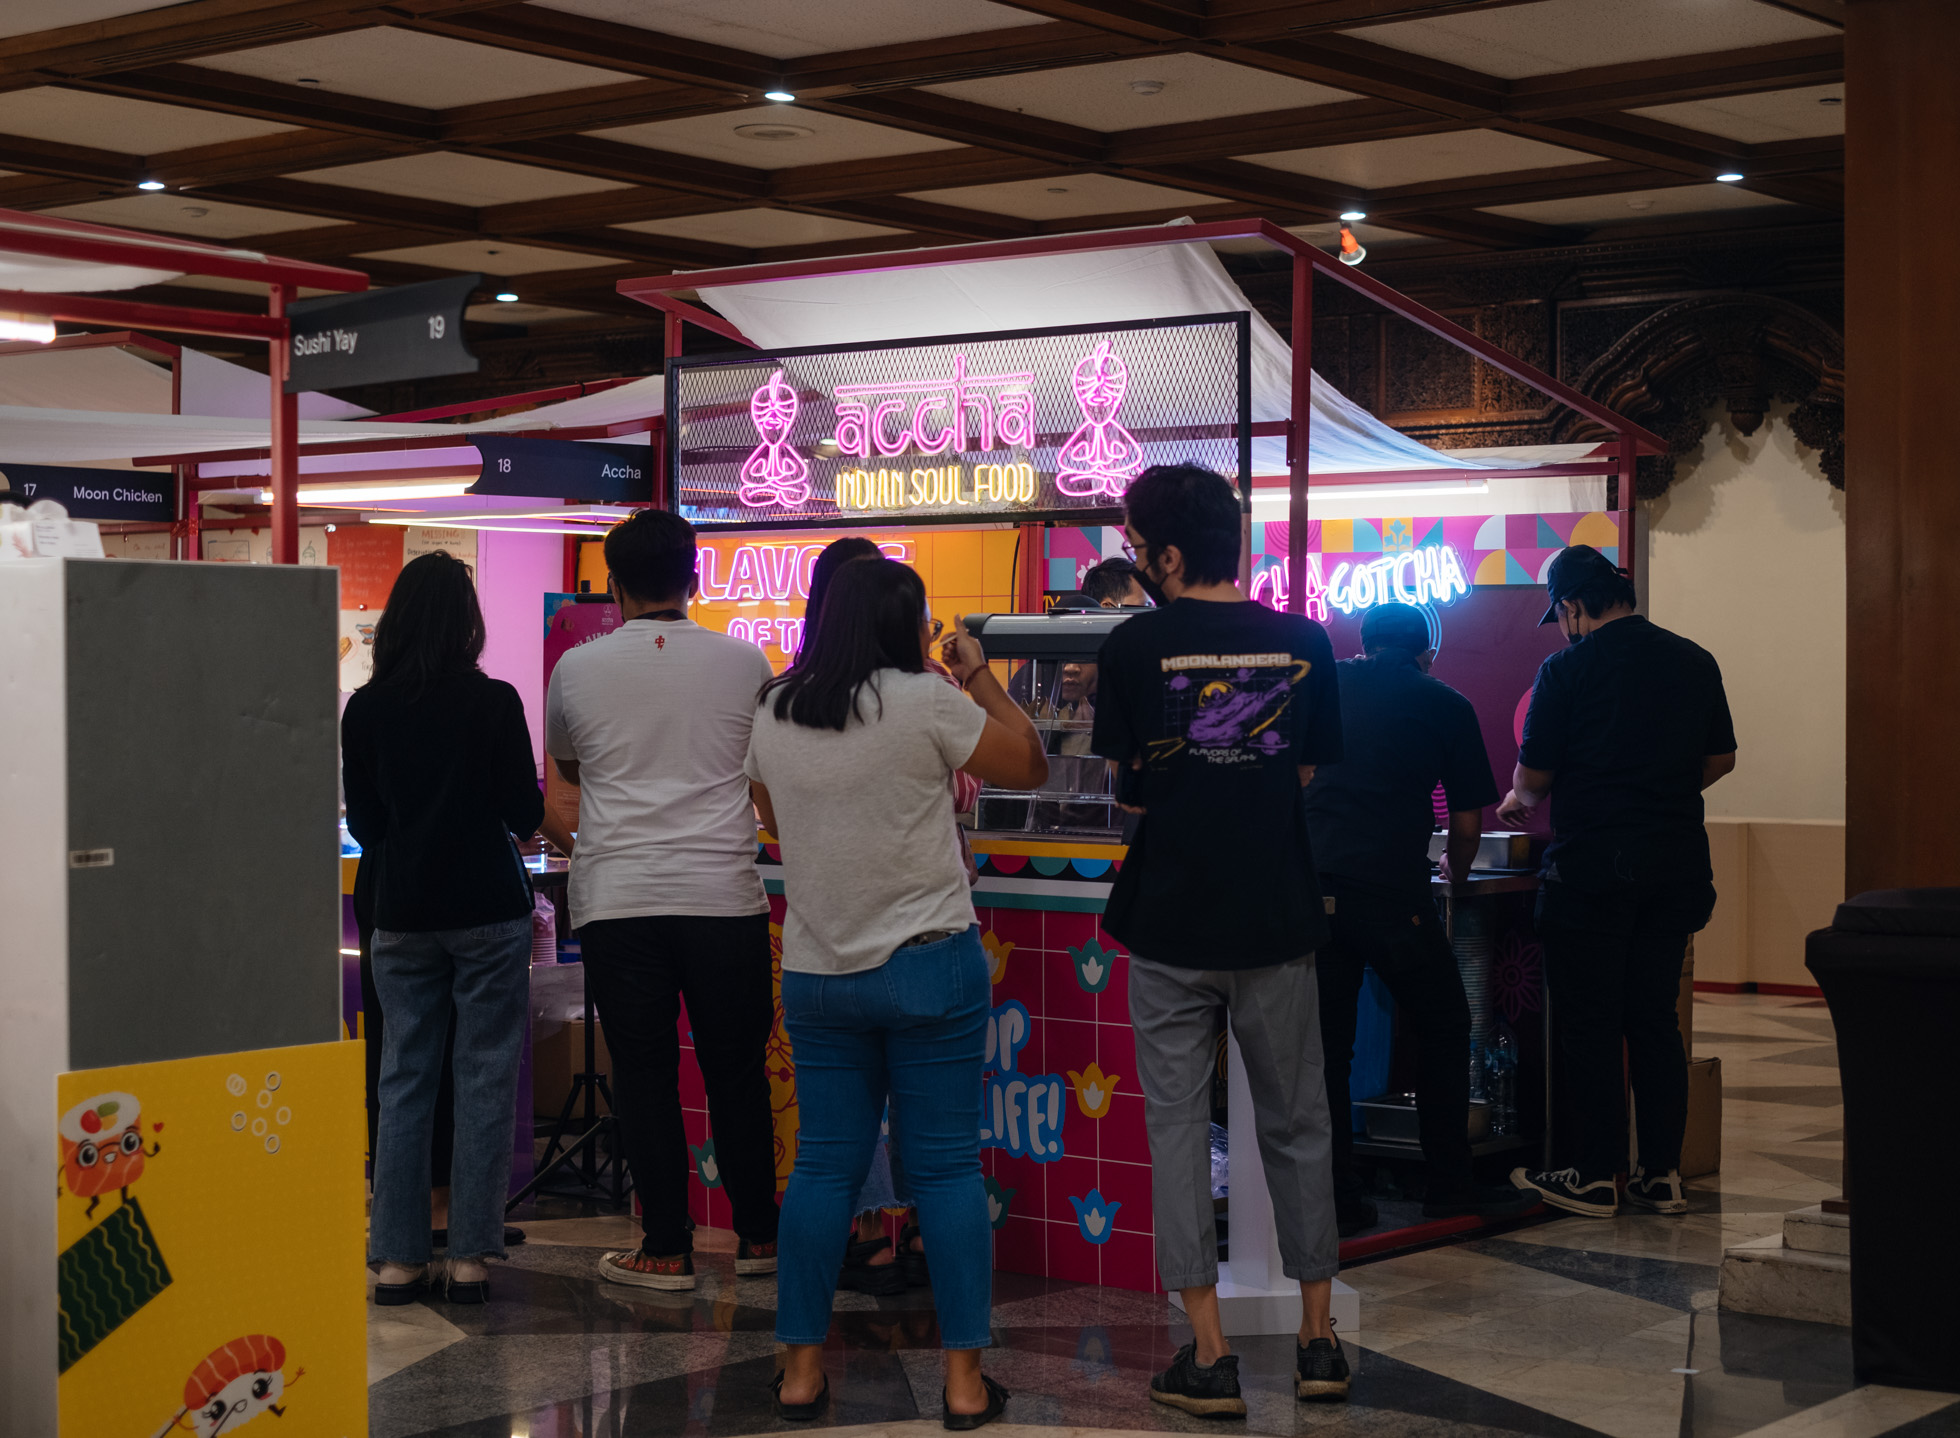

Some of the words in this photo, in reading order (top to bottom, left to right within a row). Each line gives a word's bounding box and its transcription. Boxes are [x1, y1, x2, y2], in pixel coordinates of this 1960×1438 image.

[294, 331, 331, 356] Sushi
[333, 329, 358, 355] Yay
[428, 315, 445, 340] 19
[834, 353, 1036, 459] accha
[498, 458, 512, 473] 18
[601, 464, 642, 480] Accha
[836, 467, 905, 510] INDIAN
[909, 465, 969, 506] SOUL
[974, 462, 1036, 504] FOOD
[24, 483, 37, 497] 17
[73, 486, 110, 501] Moon
[112, 487, 163, 503] Chicken
[1328, 545, 1468, 615] GOTCHA
[1161, 653, 1293, 672] MOONLANDERS
